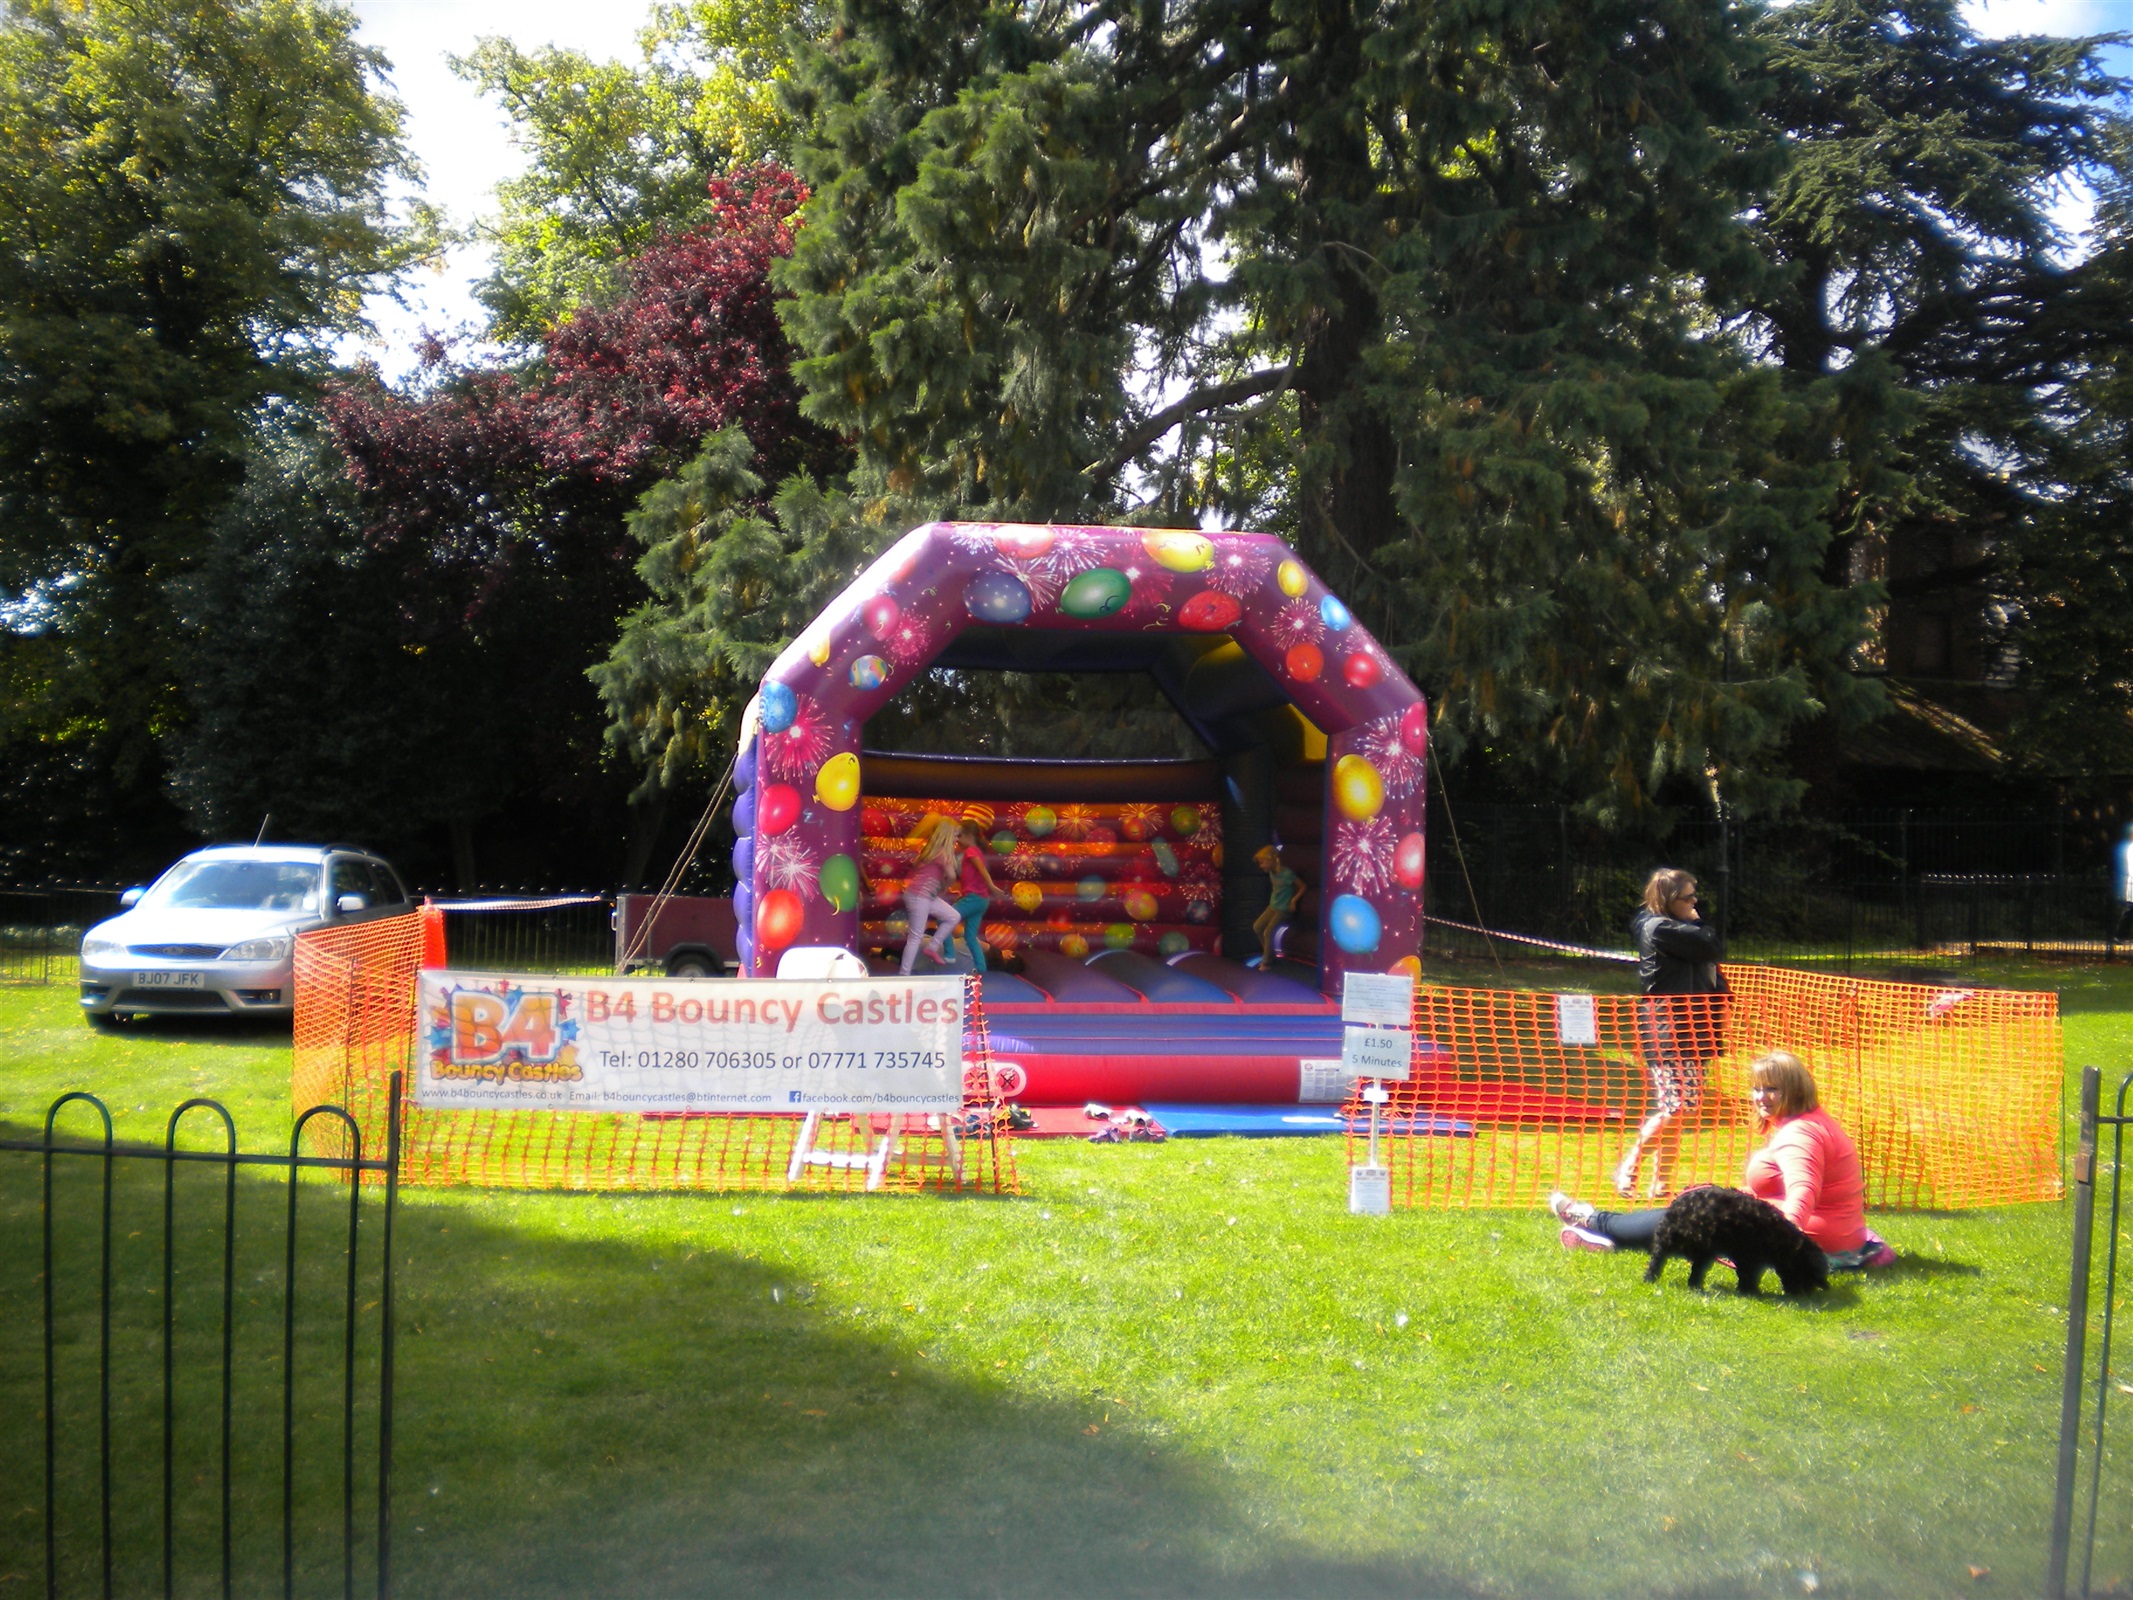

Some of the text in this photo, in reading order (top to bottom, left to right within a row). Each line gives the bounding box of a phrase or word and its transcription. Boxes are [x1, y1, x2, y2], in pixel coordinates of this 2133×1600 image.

[138, 972, 199, 985] BJ07 JFK
[586, 989, 959, 1033] B4 Bouncy Castles
[452, 991, 560, 1063] B4
[1364, 1038, 1393, 1049] £1.50
[600, 1051, 945, 1069] Tel: 01280 706305 or 07771 735745
[1352, 1054, 1403, 1068] 5 Minutes
[430, 1060, 584, 1085] Bouncy Castles
[421, 1087, 562, 1101] www.b4bouncycastles.co.uk
[569, 1090, 601, 1101] Email:
[603, 1091, 772, 1104] b4bouncycastles@btinternet.com
[802, 1092, 960, 1105] facebook.com/b4bouncycastles
